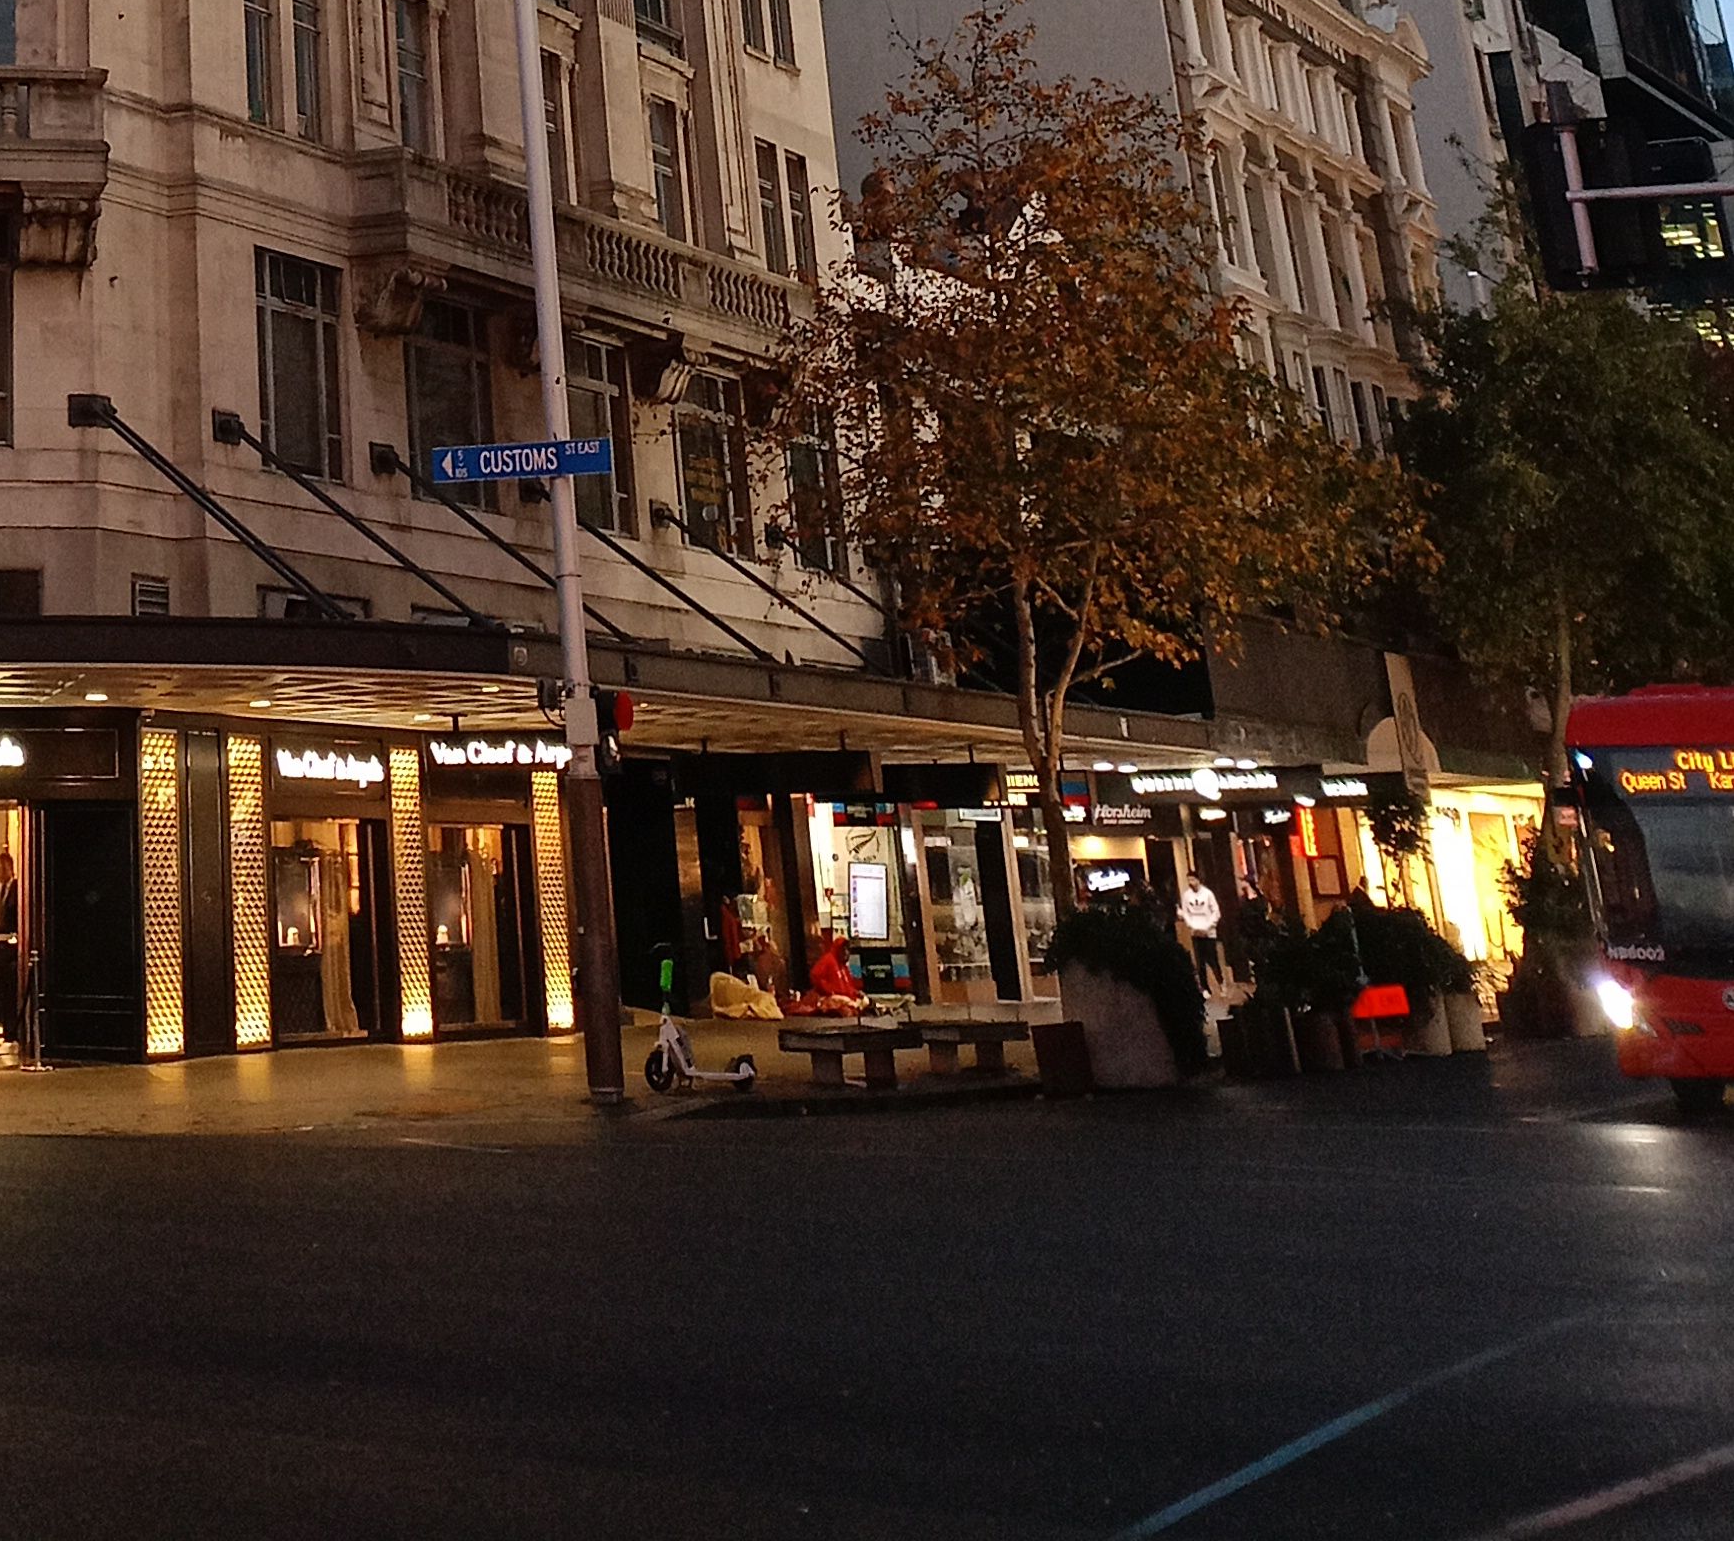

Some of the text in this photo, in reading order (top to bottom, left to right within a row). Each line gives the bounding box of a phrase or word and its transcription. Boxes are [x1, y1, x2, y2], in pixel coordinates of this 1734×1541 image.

[479, 441, 600, 474] CUSTOMS ST EAST
[1676, 752, 1715, 773] City
[1621, 772, 1666, 793] Queen
[1668, 772, 1687, 789] St
